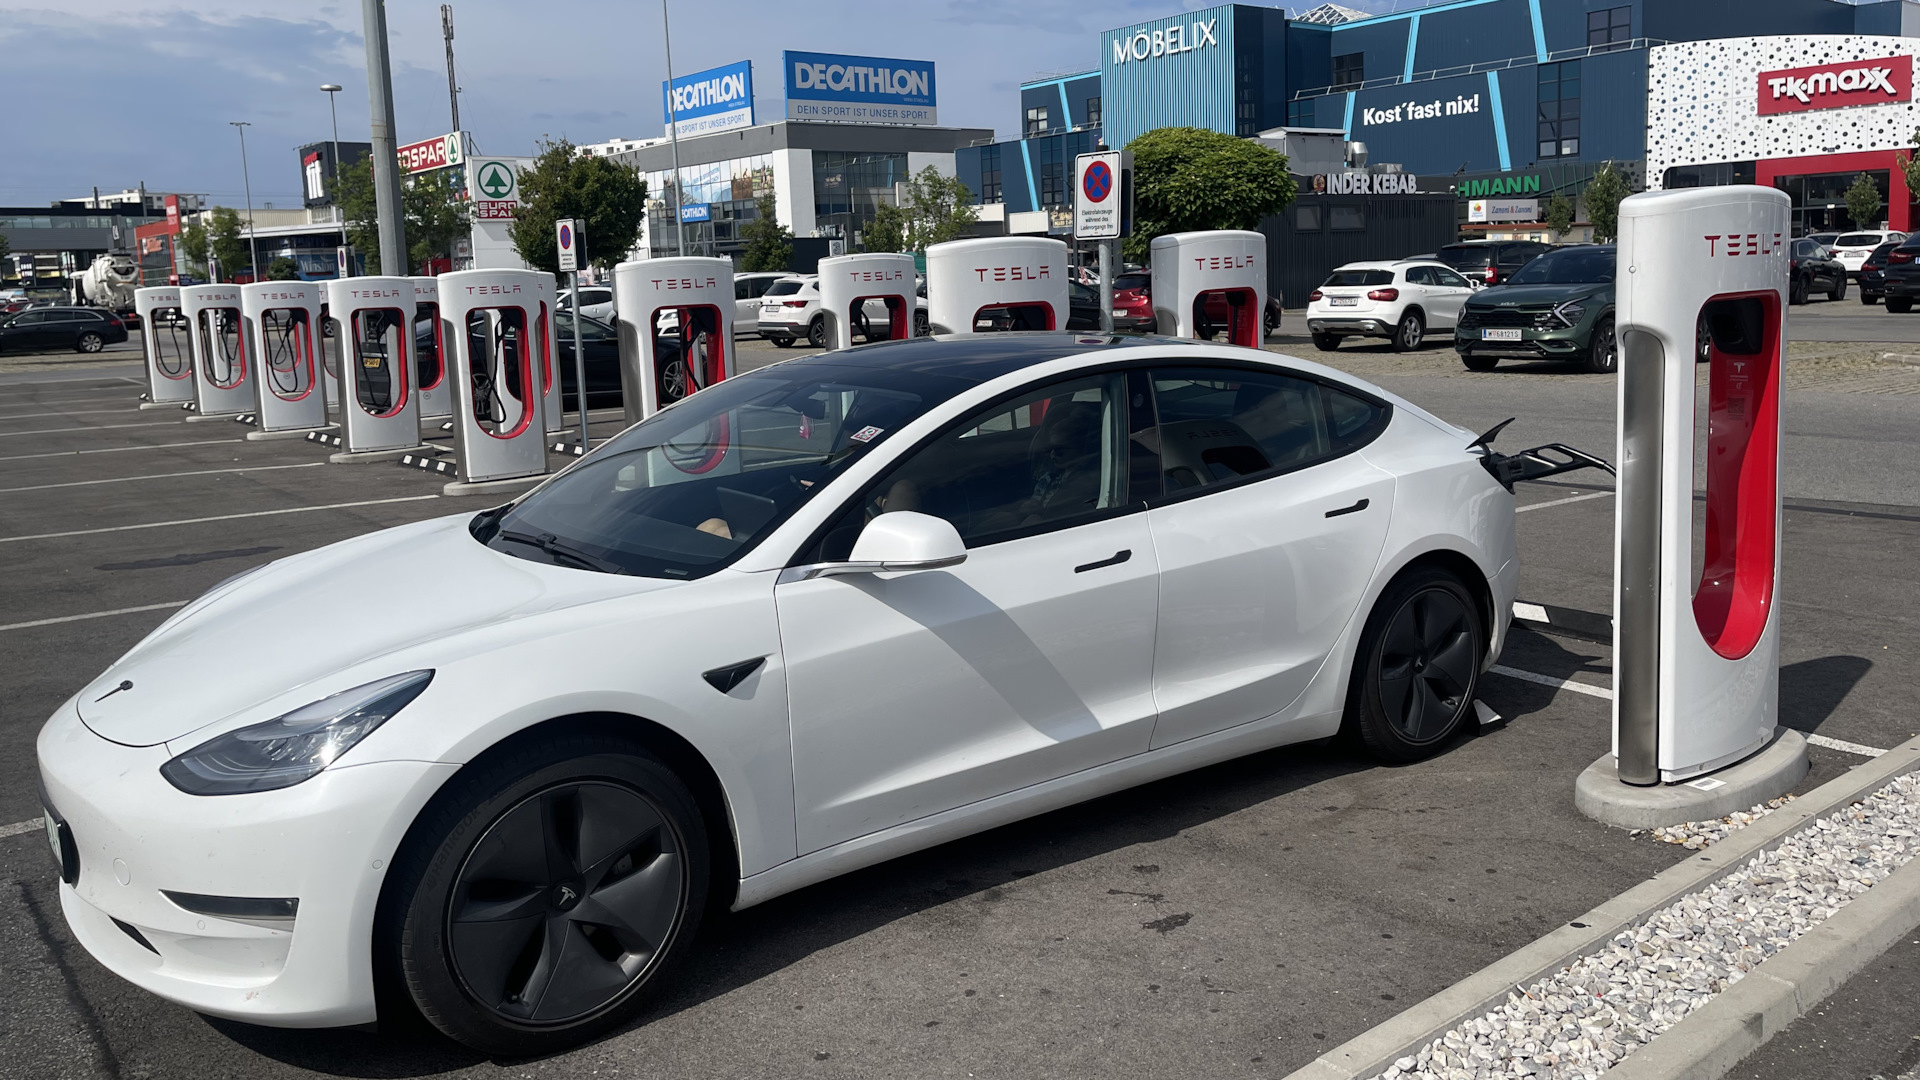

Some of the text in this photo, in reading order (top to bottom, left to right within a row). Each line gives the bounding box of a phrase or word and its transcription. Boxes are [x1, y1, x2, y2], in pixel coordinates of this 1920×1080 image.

[1113, 18, 1217, 65] MÖBELIX
[795, 62, 929, 96] DECATHLON
[667, 72, 745, 114] DECATHLON
[797, 105, 819, 115] DEIN
[821, 106, 850, 116] SPORT
[853, 108, 867, 117] IST
[869, 109, 898, 118] UNSER
[1446, 93, 1479, 116] nix!
[682, 123, 698, 133] SPORT
[699, 121, 707, 130] IST
[708, 117, 726, 128] UNSER
[396, 141, 446, 169] ROSPAR
[1326, 173, 1417, 194] INDER KEBAB
[1457, 174, 1540, 198] HMANN
[479, 202, 517, 210] EURO
[681, 206, 708, 219] ECATHLON
[1510, 206, 1515, 214] &
[1704, 232, 1782, 257] TESLA
[300, 259, 335, 273] Winston
[1194, 255, 1254, 271] TESLA
[849, 270, 903, 282] TESLA
[974, 265, 1050, 283] TESLA
[466, 284, 521, 295] TESLA
[651, 277, 716, 290] TESLA
[197, 293, 237, 301] TESLA
[261, 292, 305, 300] TESLA
[351, 289, 400, 298] TESLA
